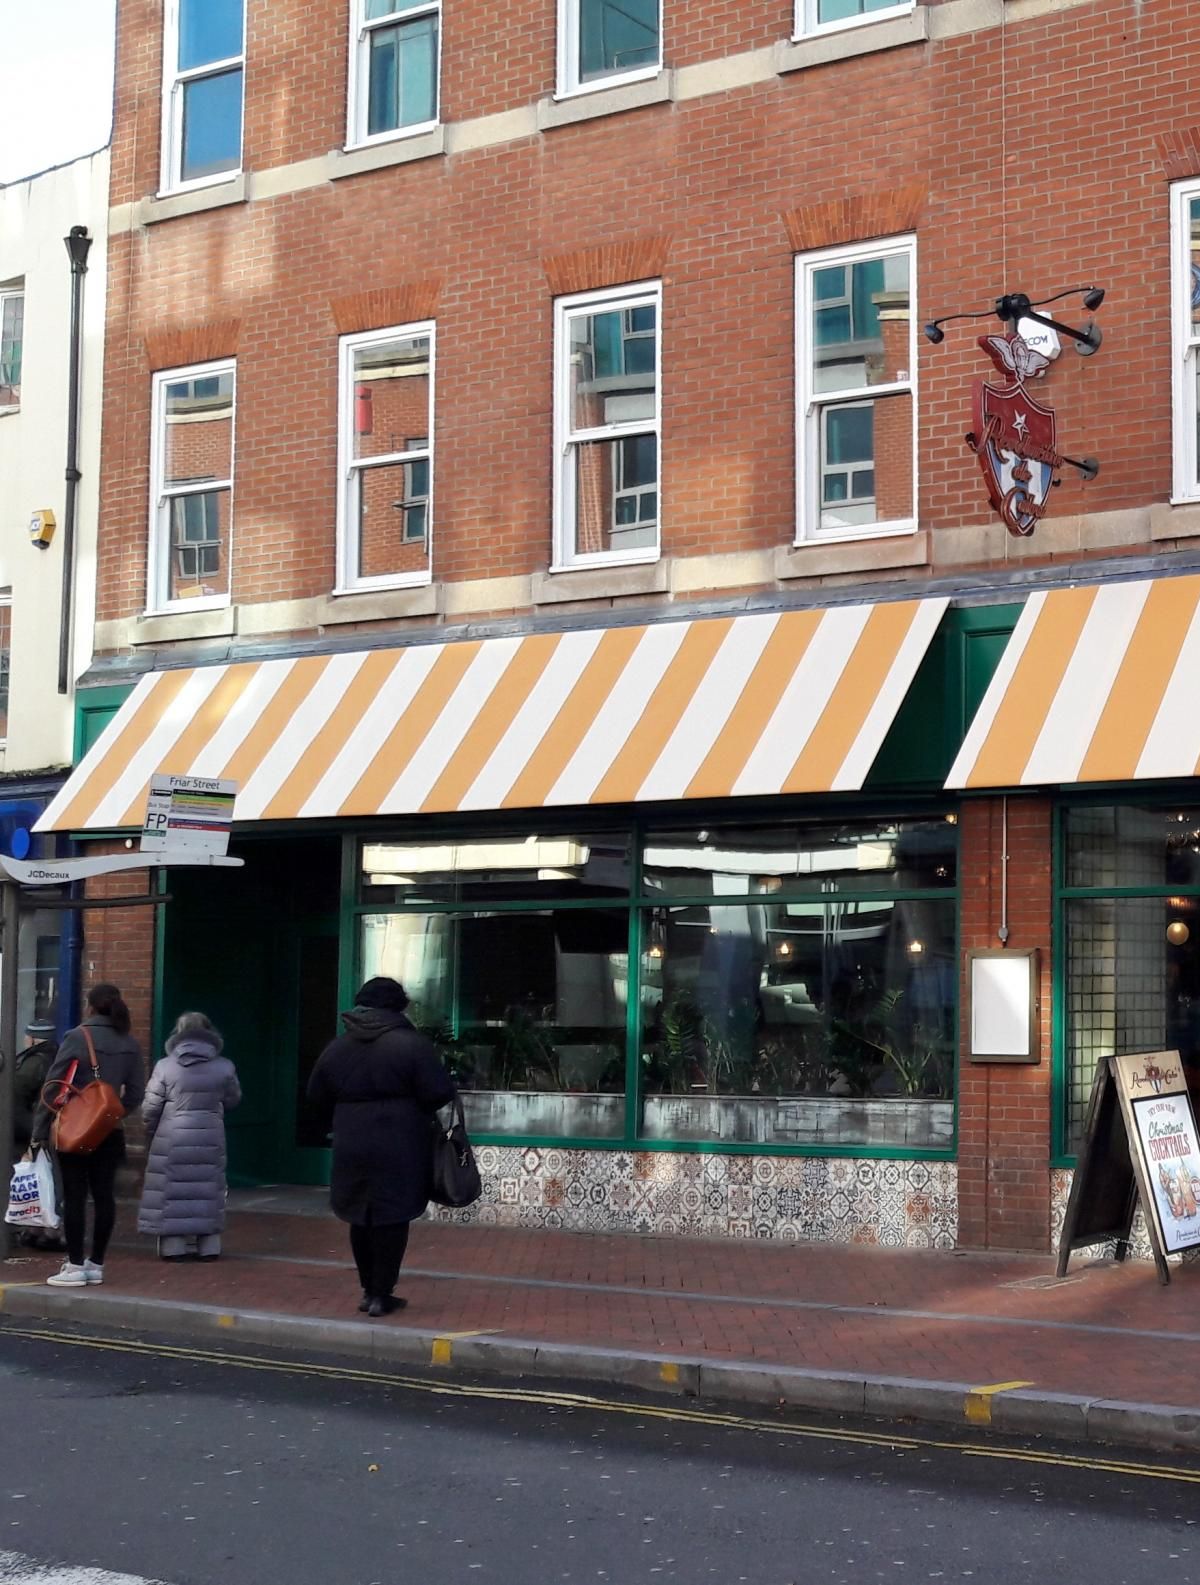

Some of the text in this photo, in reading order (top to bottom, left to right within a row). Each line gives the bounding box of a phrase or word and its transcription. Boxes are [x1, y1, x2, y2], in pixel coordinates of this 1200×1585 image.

[169, 777, 220, 789] Friar Street
[145, 813, 167, 829] FP
[27, 869, 70, 879] JCDecaux
[1148, 1121, 1185, 1139] Christmas
[1148, 1133, 1191, 1162] COCKTAILS
[10, 1180, 38, 1193] RAN
[10, 1191, 39, 1202] ALOR
